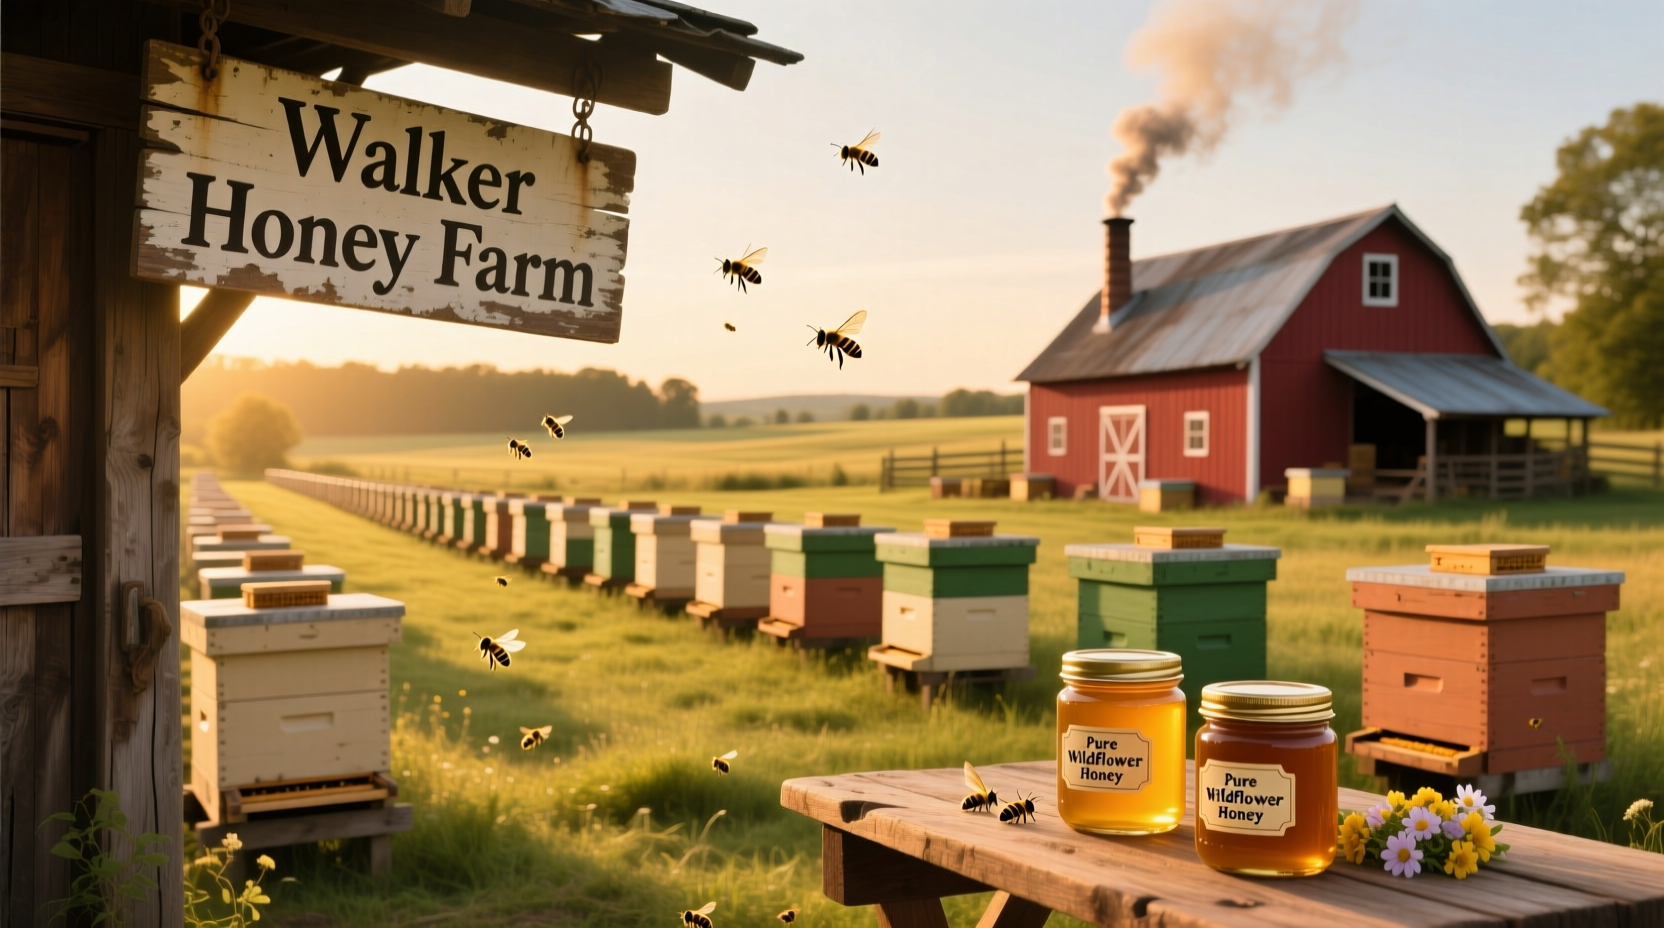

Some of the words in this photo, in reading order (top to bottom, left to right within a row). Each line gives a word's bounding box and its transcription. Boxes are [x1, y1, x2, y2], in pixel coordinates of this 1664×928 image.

[278, 97, 535, 215] Walker
[181, 172, 420, 296] Honey
[434, 219, 594, 307] Farm
[1086, 736, 1118, 750] Pure
[1068, 750, 1143, 768] Wildflower
[1080, 767, 1123, 785] Honey
[1224, 773, 1257, 788] Pure
[1206, 787, 1284, 806] Wildflower
[1218, 806, 1264, 825] Honey
